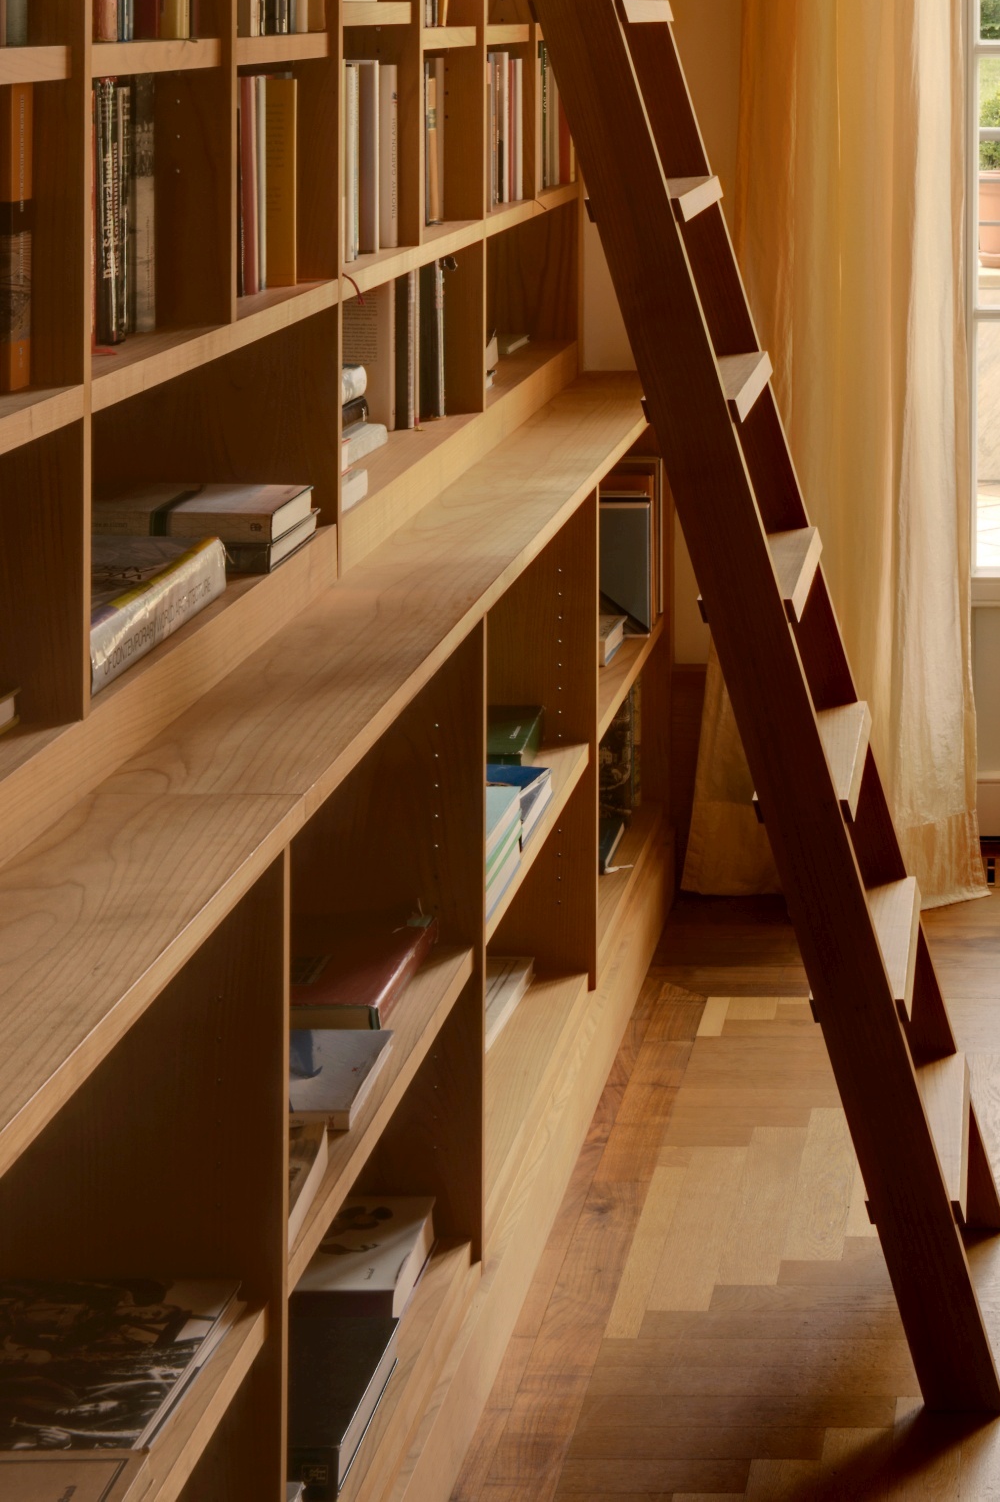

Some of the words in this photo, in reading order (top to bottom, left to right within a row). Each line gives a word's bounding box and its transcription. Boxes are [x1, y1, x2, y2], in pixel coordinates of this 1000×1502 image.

[102, 153, 113, 247] Schwarzbuch
[103, 252, 113, 279] Das
[112, 621, 156, 668] CONTEMPORARY
[156, 605, 174, 632] WORLD
